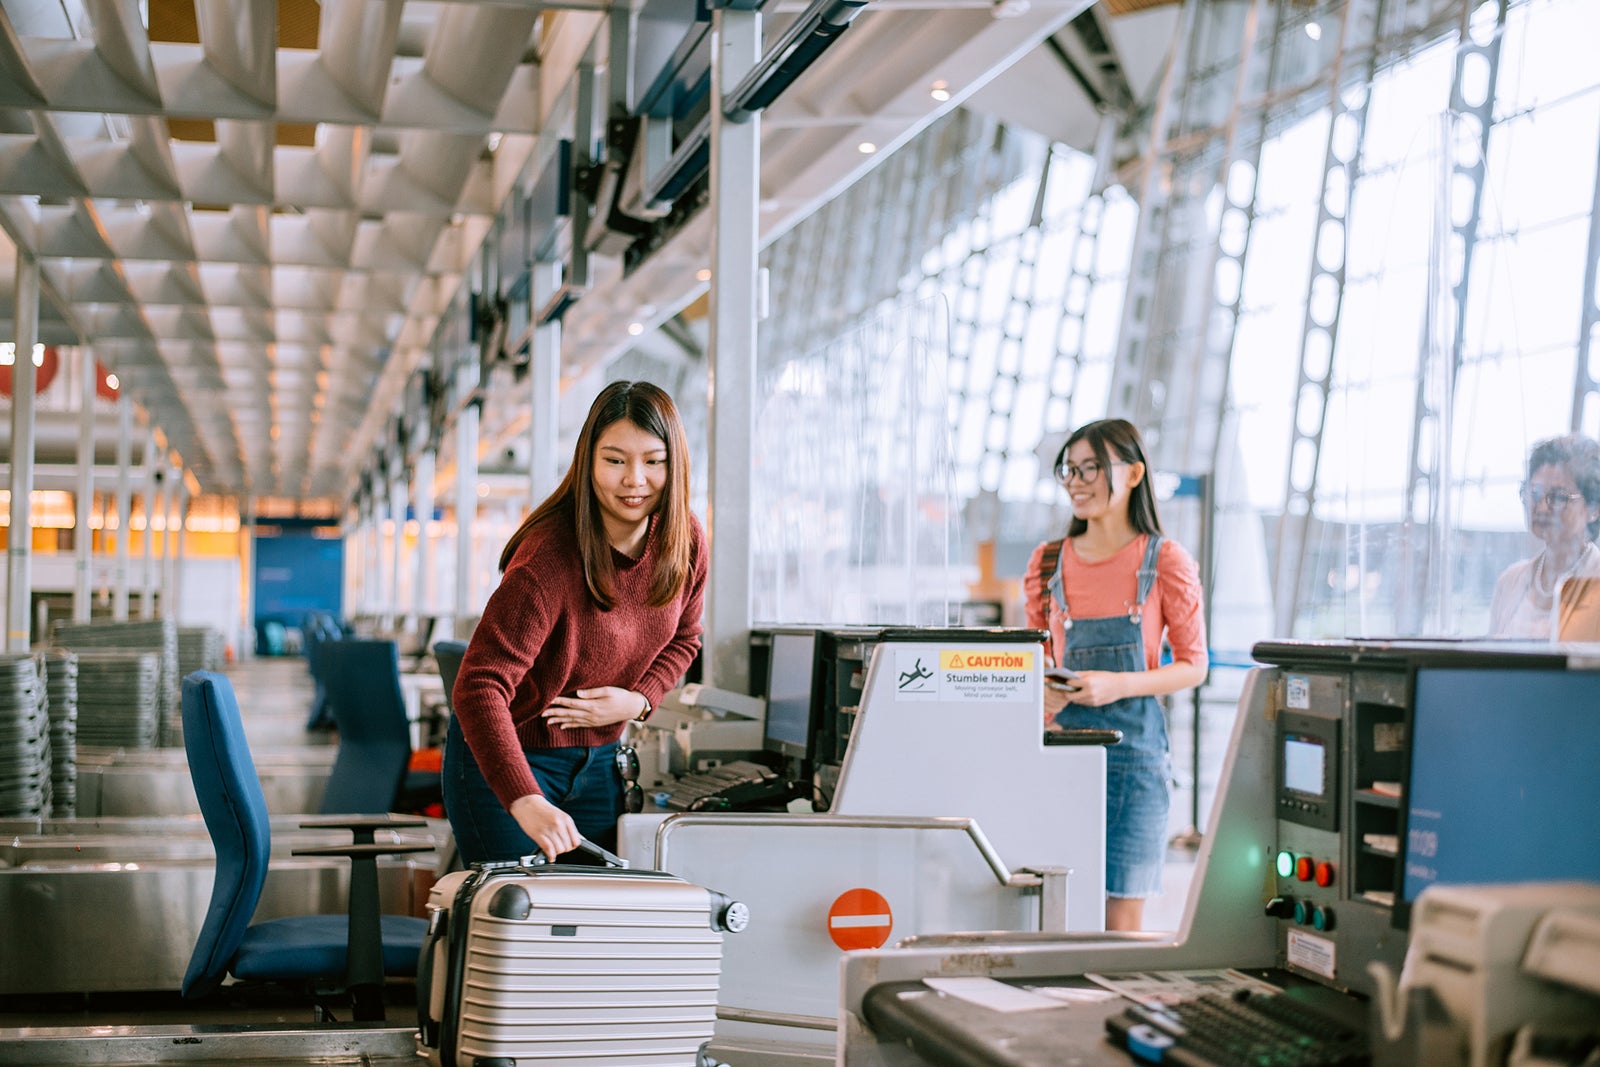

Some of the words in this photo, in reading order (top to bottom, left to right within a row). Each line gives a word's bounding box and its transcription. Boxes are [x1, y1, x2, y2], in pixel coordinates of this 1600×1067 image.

[967, 655, 1023, 667] CAUTION
[946, 673, 988, 683] Stumble
[991, 673, 1026, 683] hazard
